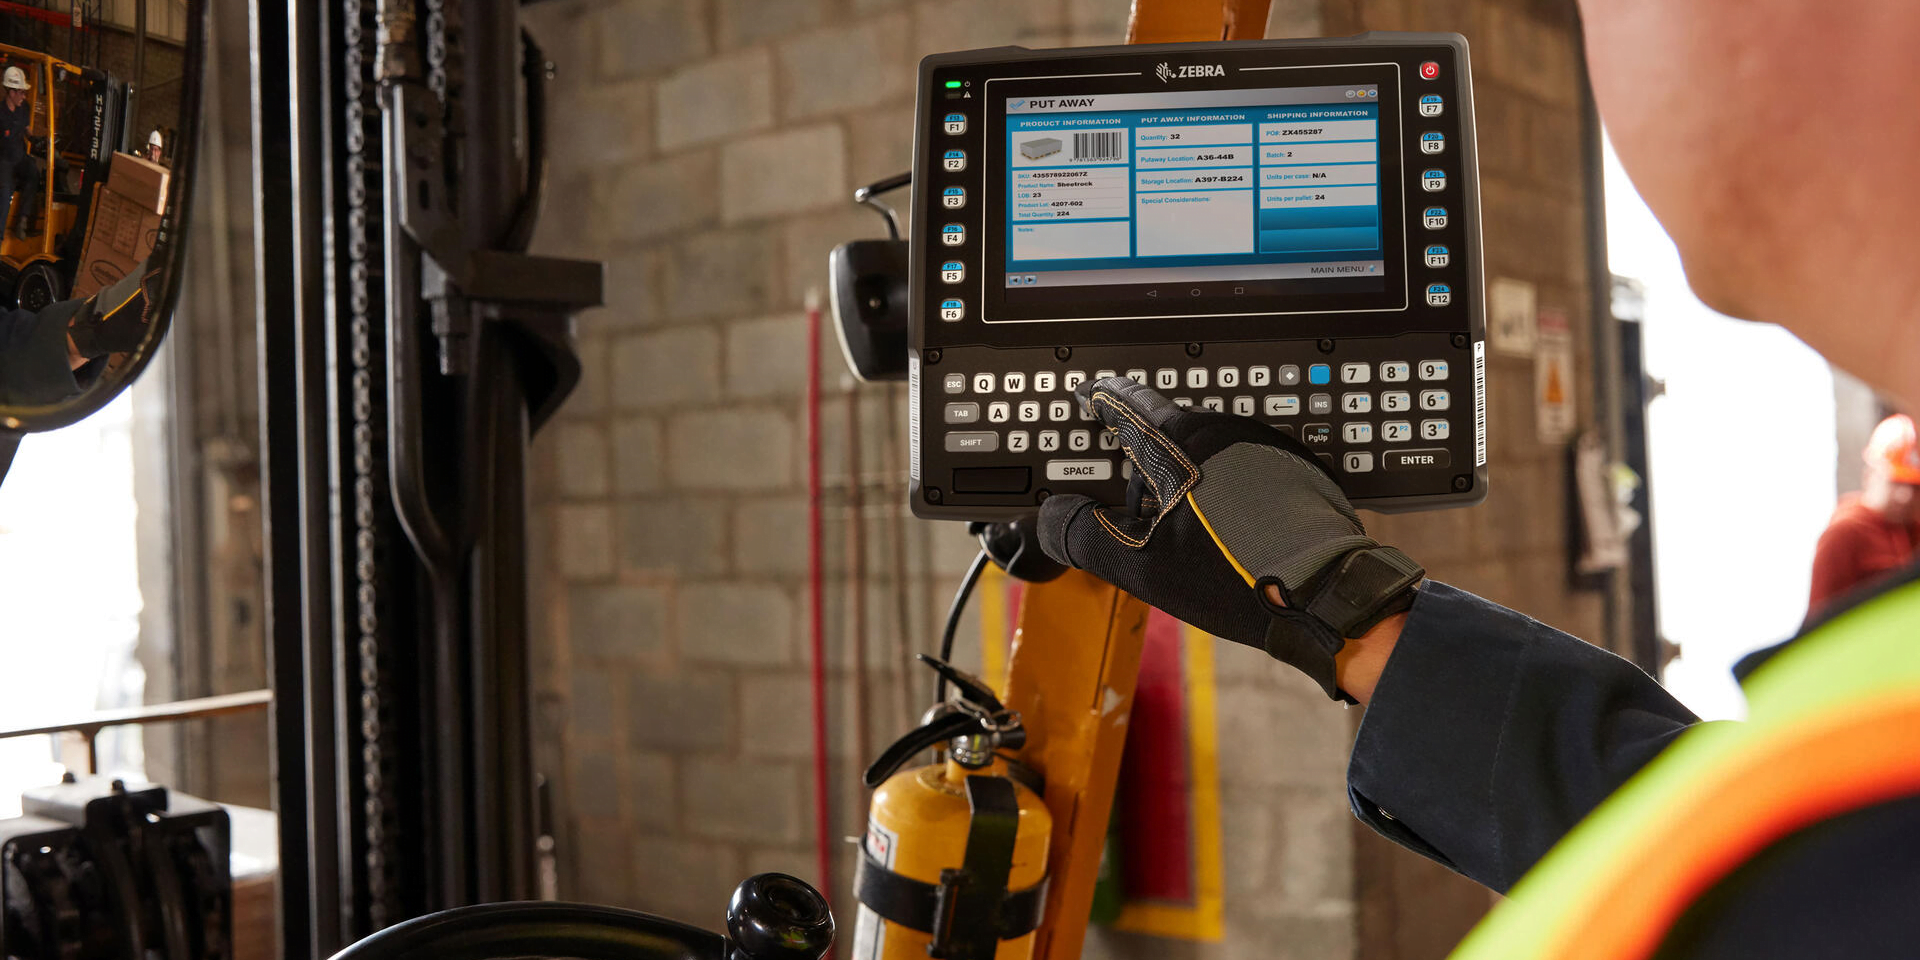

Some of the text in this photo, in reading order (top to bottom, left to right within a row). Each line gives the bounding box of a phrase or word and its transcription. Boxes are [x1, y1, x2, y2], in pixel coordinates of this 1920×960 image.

[1178, 64, 1226, 78] ZEBRA
[1029, 98, 1095, 109] PUT AWAY
[1426, 105, 1438, 113] F7
[1186, 114, 1246, 122] INFORMATION
[1309, 110, 1369, 118] INFORMATION
[1062, 118, 1121, 126] INFORMATION
[1282, 128, 1323, 136] ZX455287
[1428, 142, 1439, 150] F8
[948, 160, 959, 168] F2
[1194, 175, 1244, 183] A397-B224
[1429, 180, 1441, 188] F9
[947, 197, 959, 205] F3
[1428, 217, 1445, 226] F10
[947, 234, 958, 242] F4
[1430, 256, 1446, 264] F11
[1336, 265, 1365, 273] MENU
[946, 272, 957, 280] F5
[1431, 295, 1448, 303] F12
[945, 310, 957, 318] F6
[1347, 368, 1357, 380] 7
[1386, 366, 1396, 379] 8
[1425, 365, 1435, 377] 9
[1040, 377, 1049, 389] E
[1070, 377, 1080, 388] R
[1162, 374, 1172, 386] U
[1196, 374, 1200, 385] I
[1224, 372, 1234, 384] O
[1255, 372, 1264, 383] P
[946, 380, 962, 388] ESC
[979, 379, 989, 391] Q
[1007, 378, 1021, 389] W
[1348, 397, 1359, 410] 4
[1388, 396, 1397, 409] 5
[1426, 394, 1436, 407] 6
[1024, 407, 1033, 418] S
[1055, 407, 1064, 418] D
[1241, 402, 1248, 413] L
[993, 408, 1004, 419] A
[1350, 427, 1357, 440] 1
[1388, 426, 1398, 438] 2
[1427, 424, 1437, 437] 3
[1013, 437, 1022, 448] Z
[1043, 436, 1053, 448] X
[1074, 436, 1084, 447] C
[1104, 435, 1115, 447] V
[1308, 434, 1328, 443] PgUp
[1350, 457, 1360, 469] 0
[1400, 455, 1434, 465] ENTER
[1063, 466, 1095, 476] SPACE
